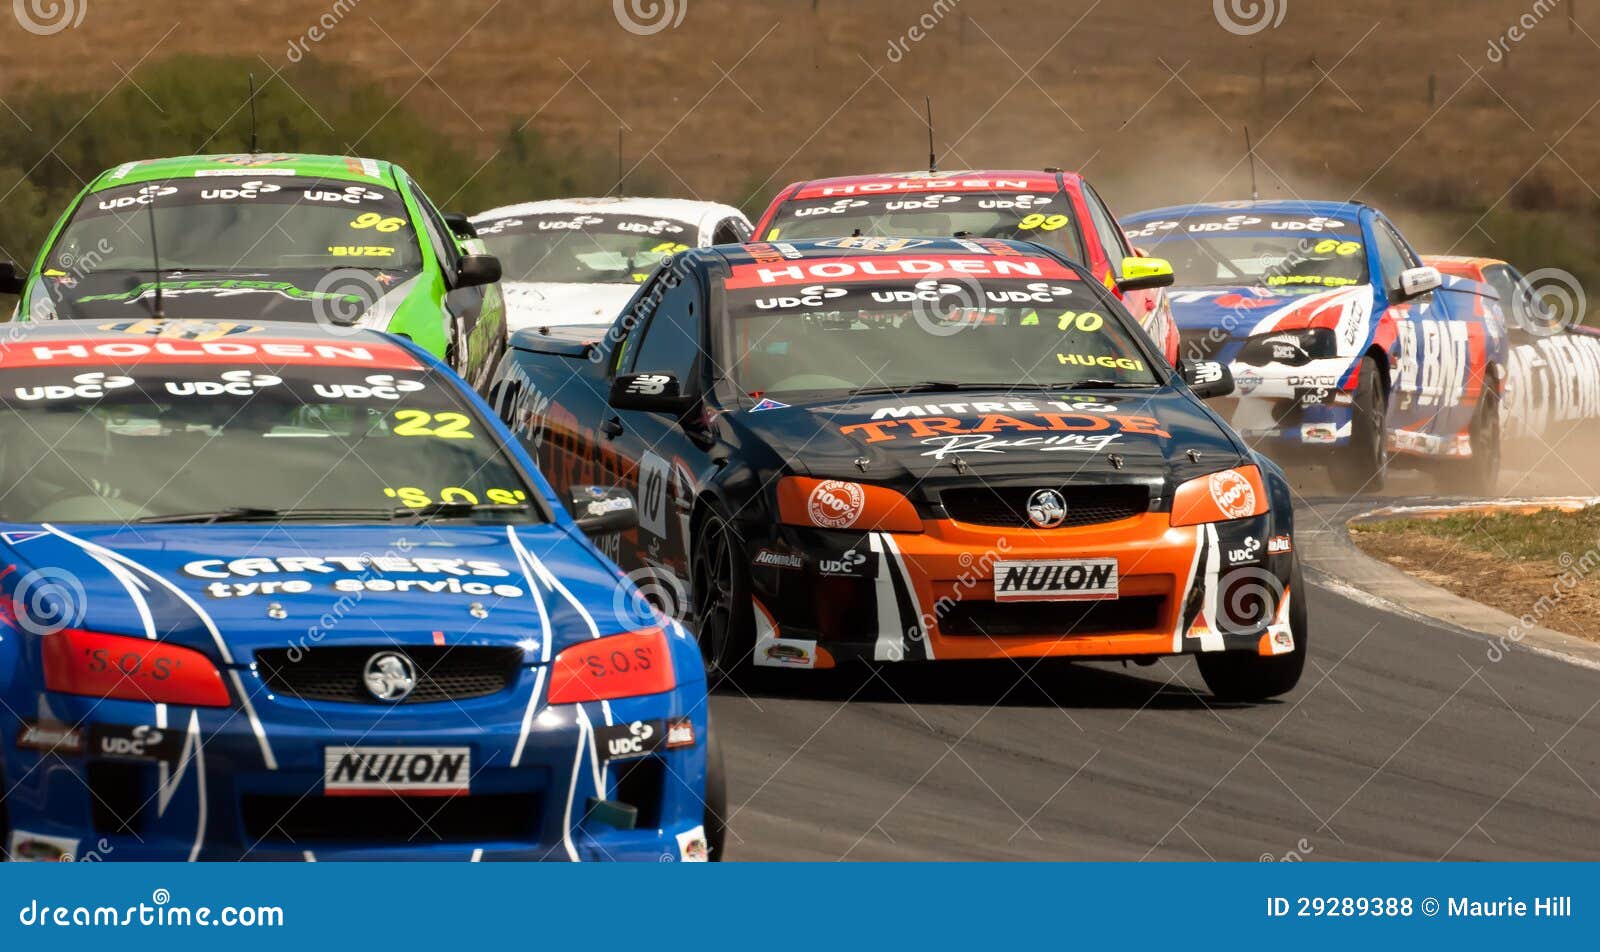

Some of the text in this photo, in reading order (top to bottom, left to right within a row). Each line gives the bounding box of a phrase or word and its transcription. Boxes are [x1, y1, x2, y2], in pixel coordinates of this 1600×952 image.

[823, 180, 1028, 195] HOLDEN
[350, 212, 407, 233] 96
[1017, 213, 1069, 231] 99
[1314, 239, 1361, 255] 66
[757, 260, 1042, 283] HOLDEN
[1057, 311, 1104, 332] 10
[32, 343, 373, 361] HOLDEN
[1056, 353, 1144, 372] HUGGI
[870, 401, 1040, 420] MITRE
[393, 409, 475, 439] 22
[840, 413, 1172, 443] TRADE
[920, 433, 1125, 460] Racing
[645, 467, 661, 522] 10
[817, 489, 855, 519] 100%
[183, 556, 510, 578] CARTER'S
[207, 578, 523, 598] tyre service
[1000, 564, 1112, 592] NULON
[331, 753, 464, 783] NULON
